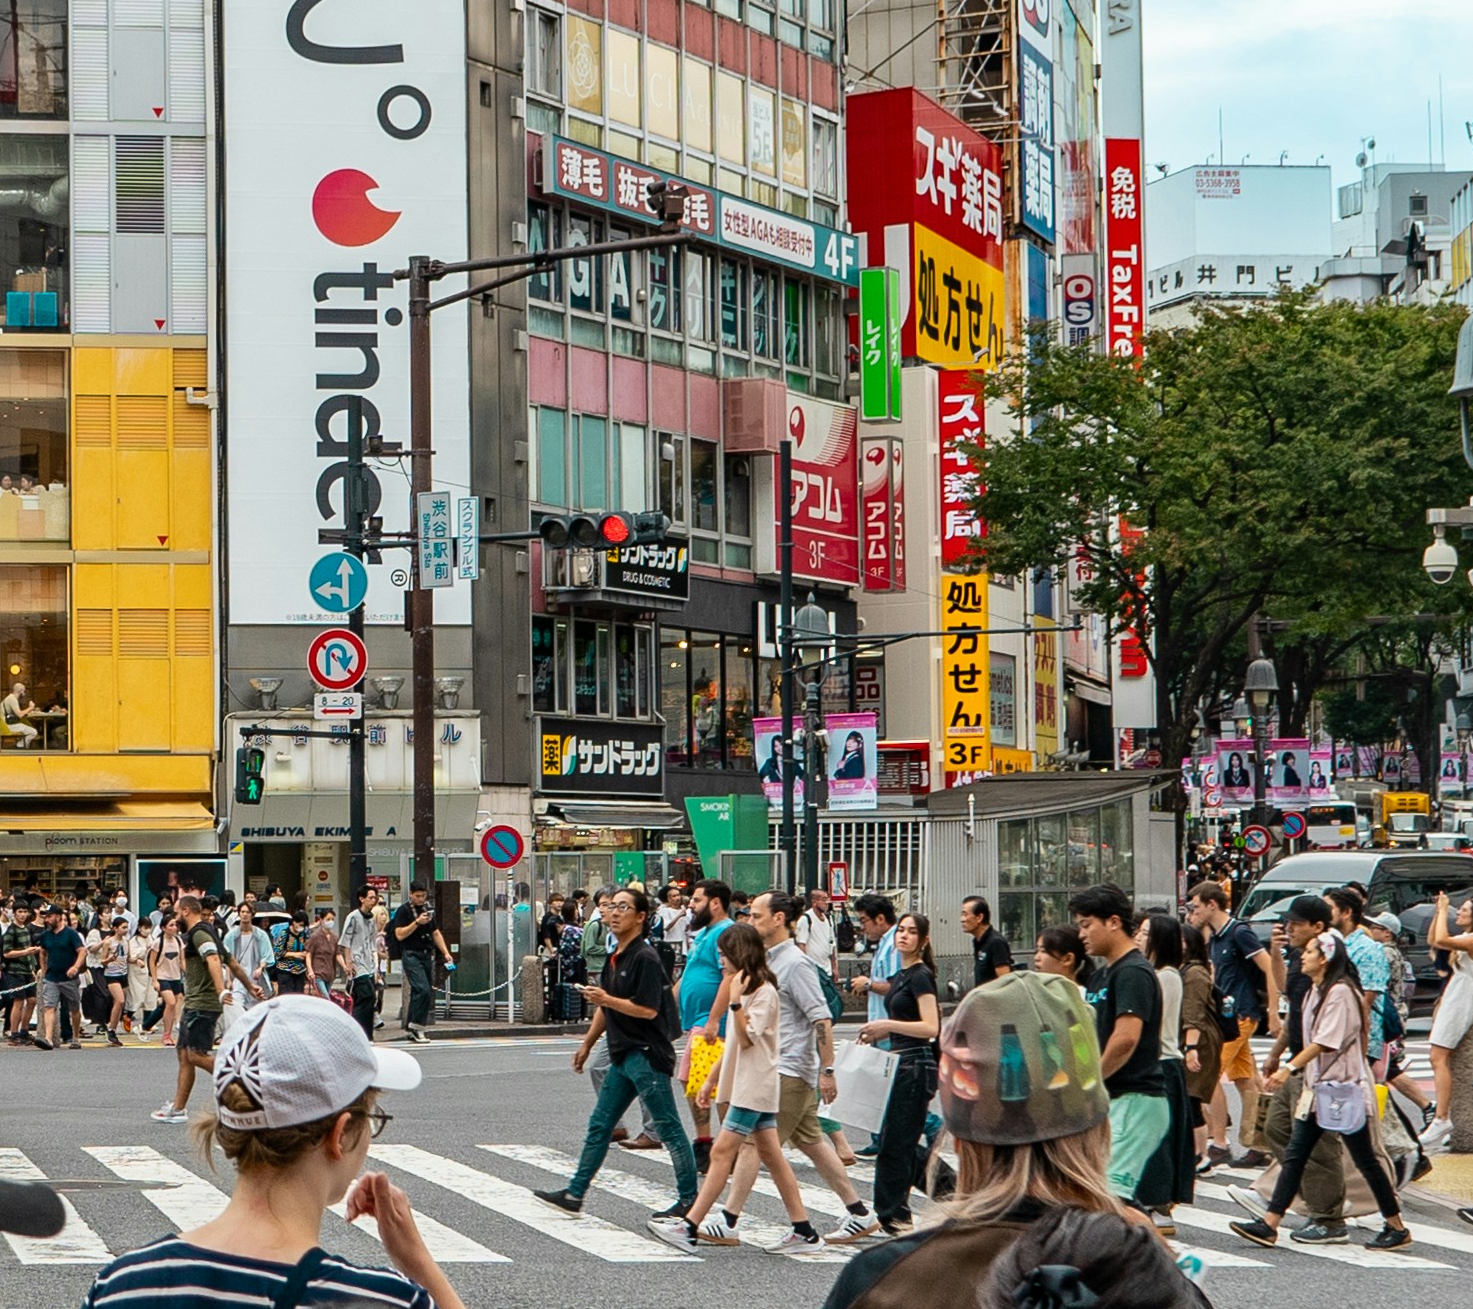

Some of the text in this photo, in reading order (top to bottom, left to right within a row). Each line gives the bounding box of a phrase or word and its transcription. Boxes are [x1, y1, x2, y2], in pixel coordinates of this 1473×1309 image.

[561, 147, 604, 198] 薄毛
[914, 125, 1004, 247] スギ薬局
[1110, 165, 1137, 221] 免税
[824, 232, 855, 281] 4F
[917, 249, 1005, 365] 処方せん
[866, 319, 882, 366] レイク
[788, 469, 843, 524] アコム
[422, 512, 432, 552] Shibuya
[431, 499, 450, 581] 渋谷駅前
[462, 500, 475, 578] スクランブル式
[809, 538, 826, 570] 3F
[868, 501, 887, 560] アコム
[622, 570, 638, 583] DRUG
[870, 566, 885, 577] 3F
[946, 580, 983, 728] 処方せん
[342, 696, 355, 706] 20
[544, 738, 560, 770] 薬
[578, 738, 661, 776] サンドラッグ
[949, 741, 984, 766] 3F
[80, 837, 119, 845] STATION
[240, 826, 306, 838] SHIBUYA
